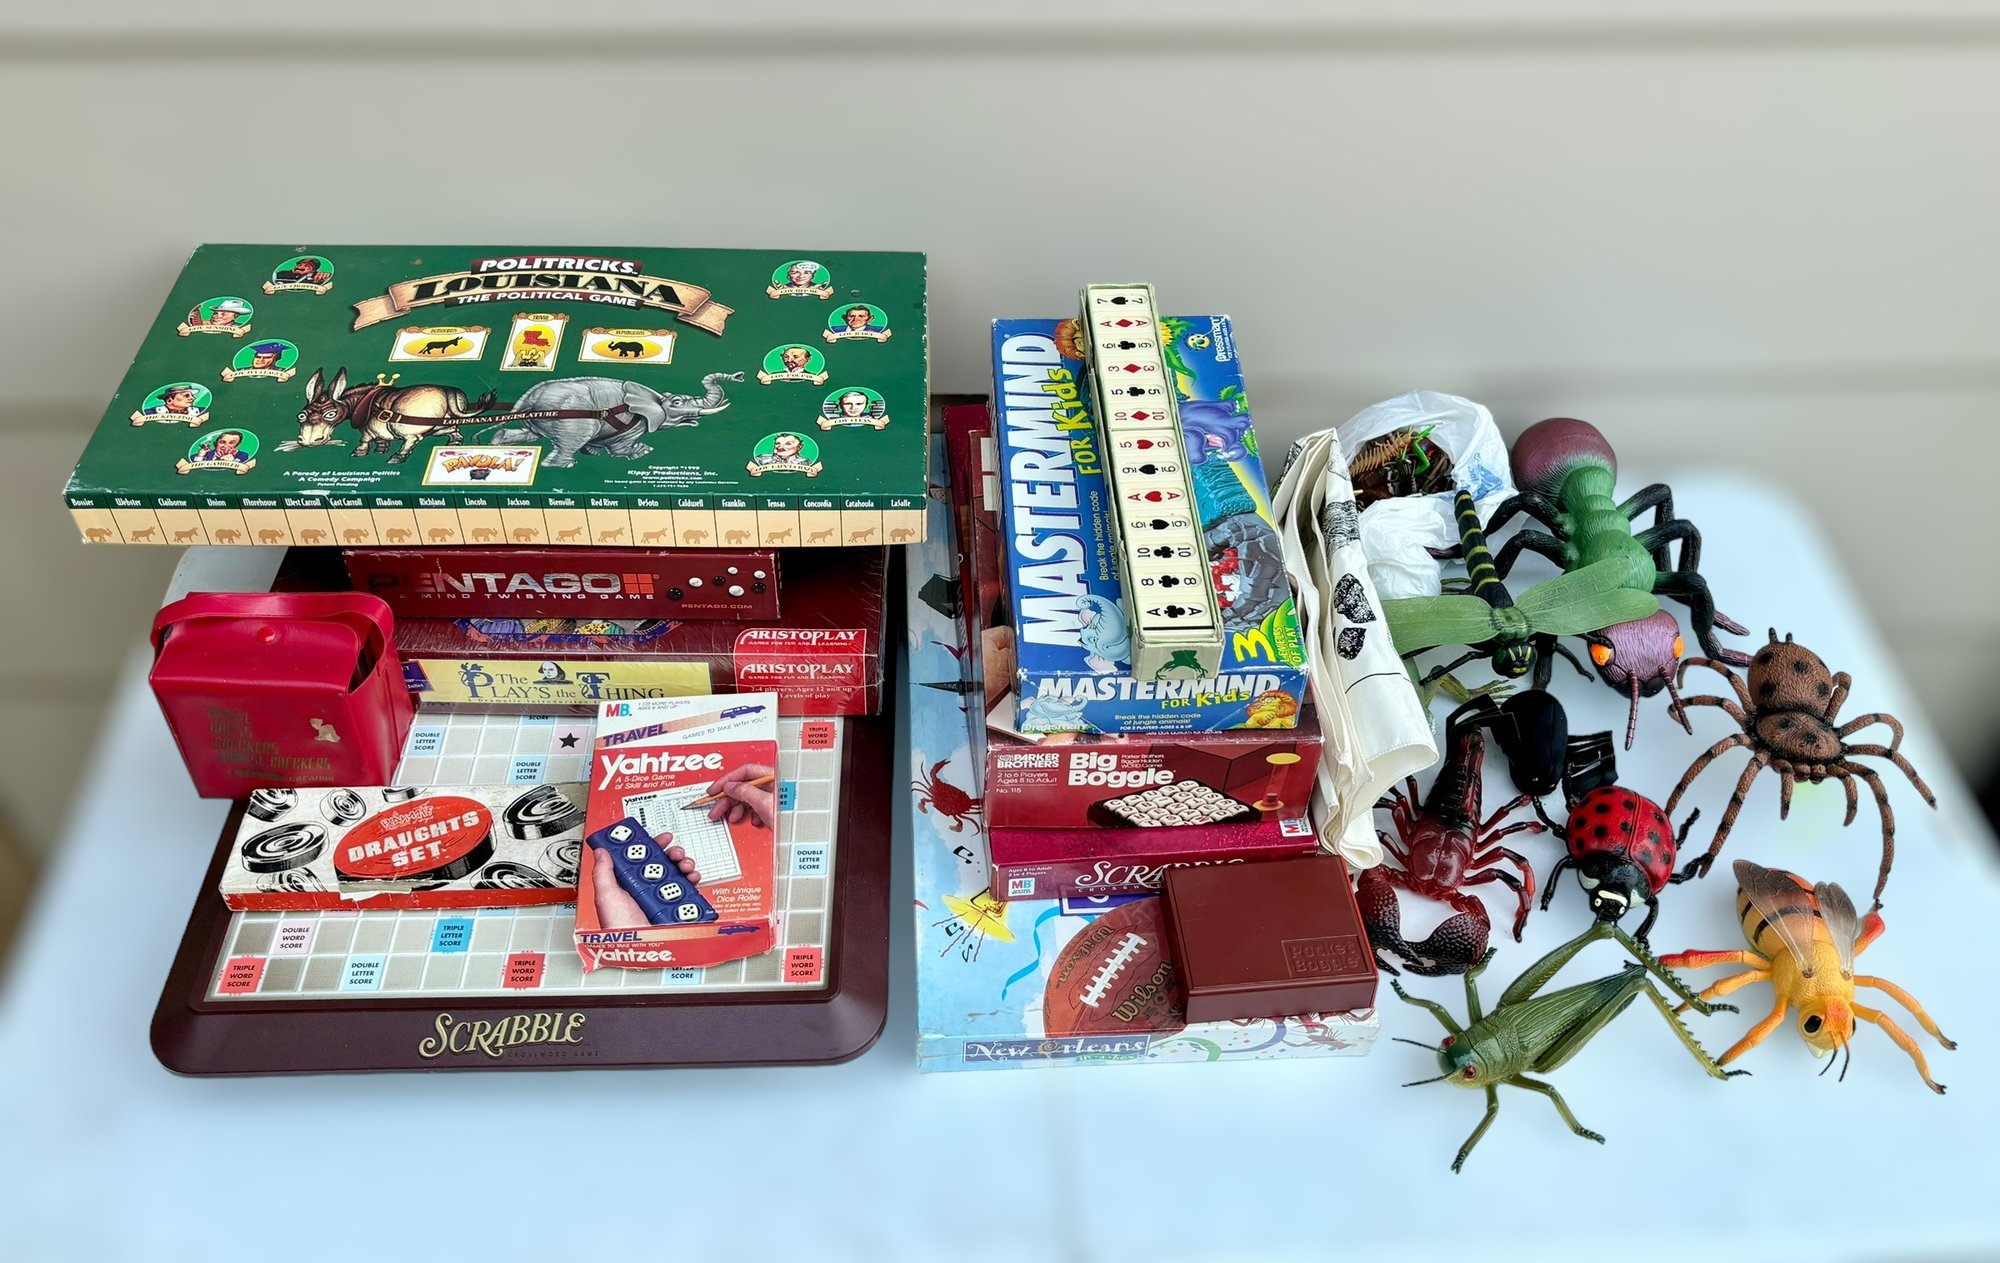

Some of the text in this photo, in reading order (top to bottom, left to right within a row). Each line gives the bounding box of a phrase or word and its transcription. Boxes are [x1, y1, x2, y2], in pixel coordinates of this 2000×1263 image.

[480, 257, 635, 274] POLITRICKS
[409, 272, 686, 307] LOUISIANA
[458, 290, 637, 307] THE POLITICAL GAME
[1211, 318, 1231, 362] Pressman
[442, 410, 559, 426] LOUISIANA LEGISLATURE
[1041, 367, 1102, 475] FOR Kids
[442, 453, 525, 473] PAYOLA!
[1001, 334, 1087, 647] MASTERMIND
[71, 498, 94, 507] Bossier
[116, 498, 141, 506] Webster
[157, 498, 187, 507] Claiborne
[207, 498, 226, 507] Union
[242, 498, 278, 507] Morehouse
[285, 498, 321, 507] West Carroll
[329, 498, 363, 507] East Carroll
[376, 498, 403, 506] Madison
[419, 498, 445, 507] Richland
[464, 498, 487, 507] Lincoln
[507, 498, 530, 506] Jackson
[548, 498, 575, 507] Bienville
[591, 498, 619, 507] Red River
[638, 498, 659, 507] DeSoto
[678, 498, 704, 507] Caldwell
[721, 498, 746, 508] Franklin
[767, 499, 786, 508] Tensas
[803, 499, 832, 508] Concordia
[845, 499, 875, 508] Catahoula
[891, 499, 911, 508] LaSalle
[1089, 490, 1108, 581] Break the hidden code
[368, 572, 622, 594] PENTAGO
[740, 631, 858, 645] ARISTOPLAY
[1233, 628, 1276, 663] 3
[1273, 627, 1290, 662] LEVELS
[1285, 627, 1302, 662] OF PLAY
[495, 673, 528, 684] The
[740, 663, 855, 679] ARISTOPLAY
[458, 663, 664, 698] PLAY'S the THING
[1037, 674, 1281, 701] MASTERMIND
[1161, 688, 1251, 710] FOR Kids
[603, 723, 668, 747] TRAVEL
[682, 731, 706, 740] GAMES
[717, 725, 733, 733] TAKE
[733, 721, 750, 729] WITH
[997, 760, 1060, 768] BROTHERS
[1070, 752, 1118, 771] Big
[598, 751, 722, 790] Yahtzee
[1068, 768, 1174, 788] Boggle
[347, 809, 480, 863] DRAUGHTS
[391, 840, 442, 868] SET
[712, 887, 761, 895] With Unique
[1011, 880, 1031, 889] MB
[716, 894, 762, 903] Dice Roller
[581, 931, 642, 942] TRAVEL
[351, 961, 379, 969] DOUBLE
[587, 949, 673, 969] Yahtzee
[1111, 961, 1173, 1023] Wilson
[418, 1012, 586, 1057] SCRABBLE
[967, 1038, 1146, 1062] New Orleans
